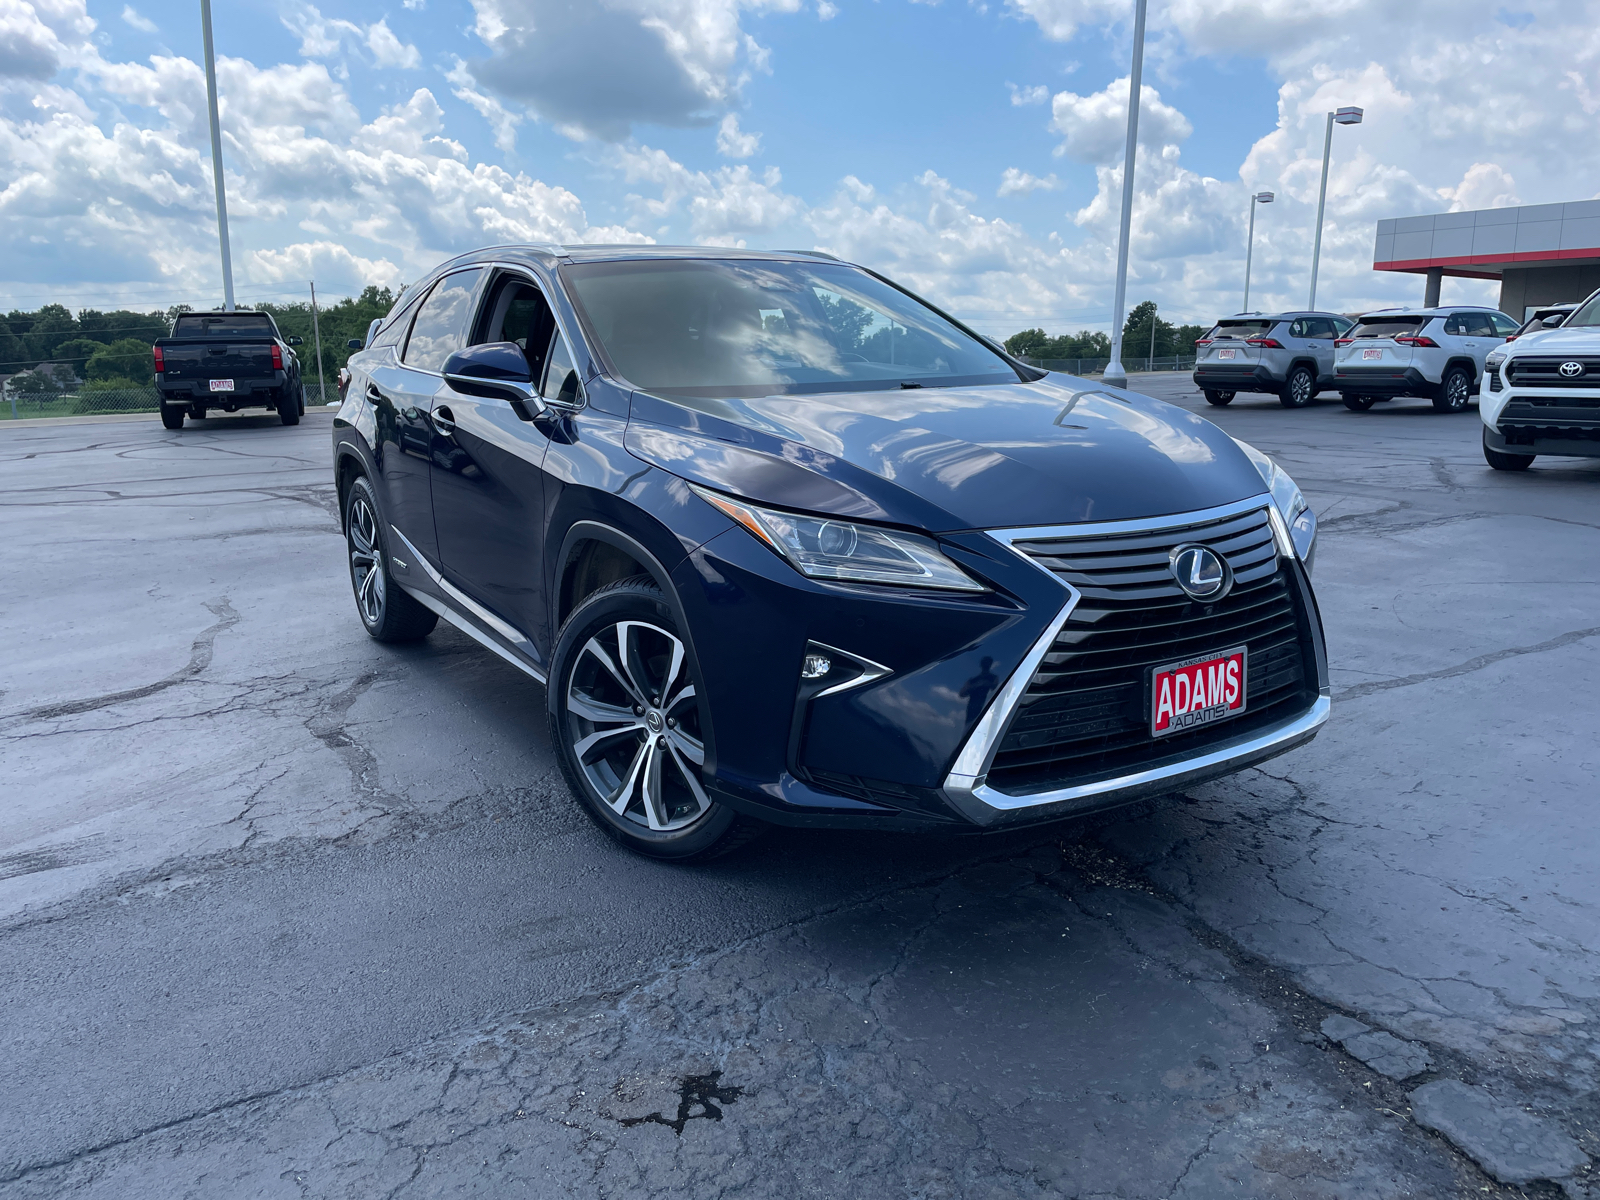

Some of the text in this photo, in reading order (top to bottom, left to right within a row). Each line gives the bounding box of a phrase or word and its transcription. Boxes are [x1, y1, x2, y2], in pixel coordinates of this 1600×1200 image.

[1178, 652, 1223, 668] KANSAS CITY
[1156, 660, 1239, 724] ADAMS
[1174, 704, 1226, 730] ADAMS
